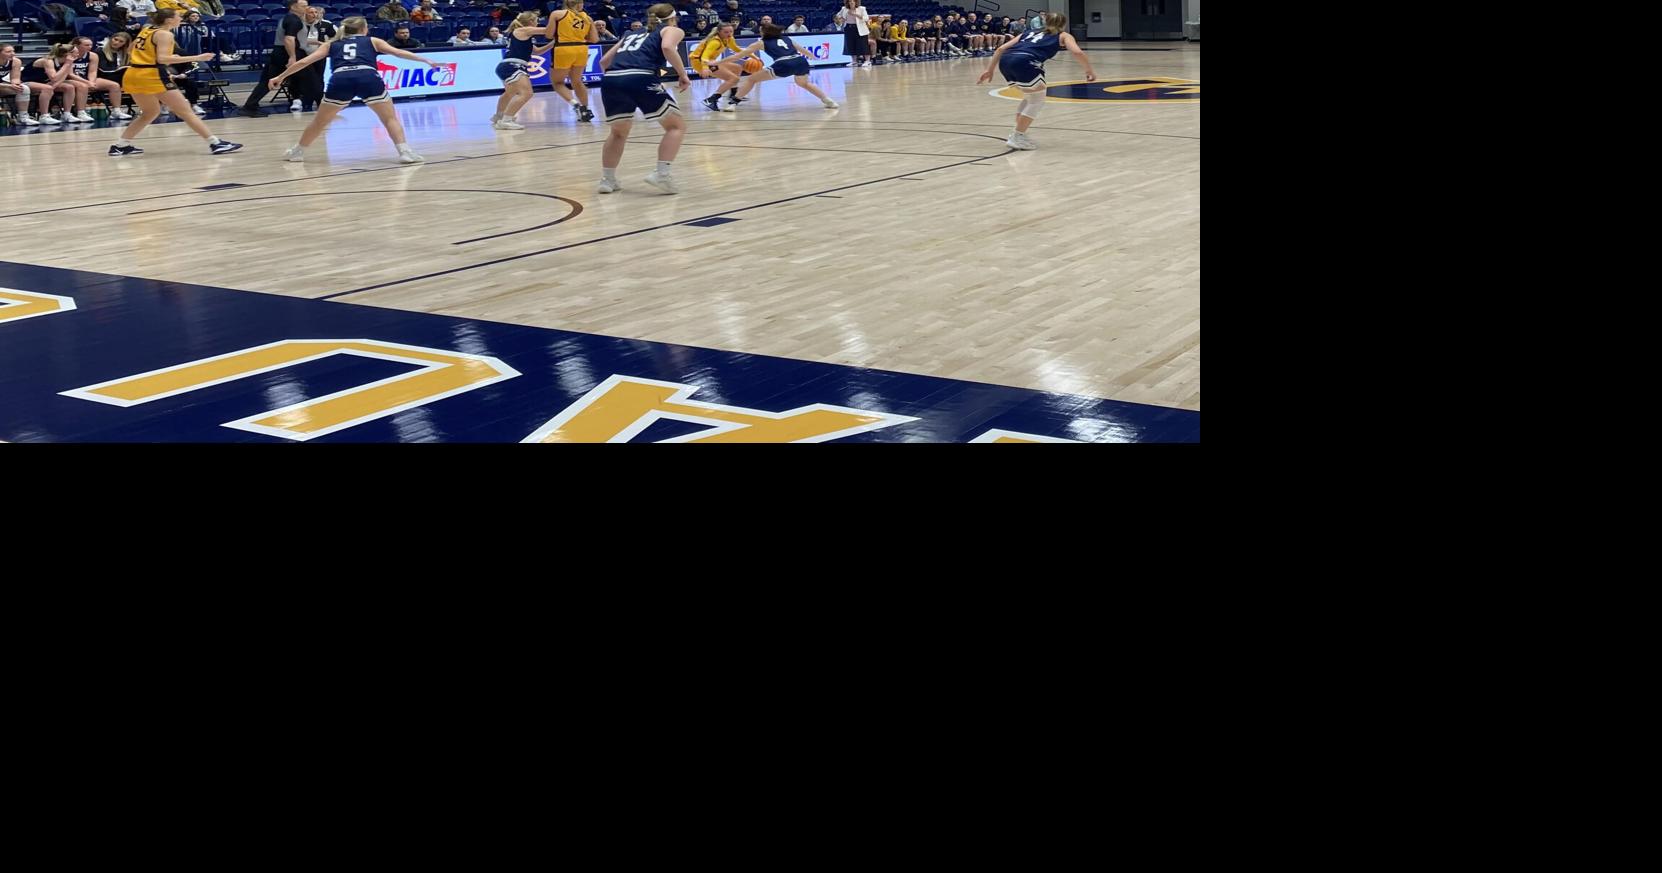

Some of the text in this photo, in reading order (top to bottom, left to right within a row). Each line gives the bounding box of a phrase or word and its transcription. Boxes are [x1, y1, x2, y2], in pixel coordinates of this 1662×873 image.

[572, 18, 585, 30] 21
[616, 32, 650, 53] 33
[776, 38, 789, 50] 4
[343, 43, 357, 60] 5
[378, 68, 440, 90] WIAC
